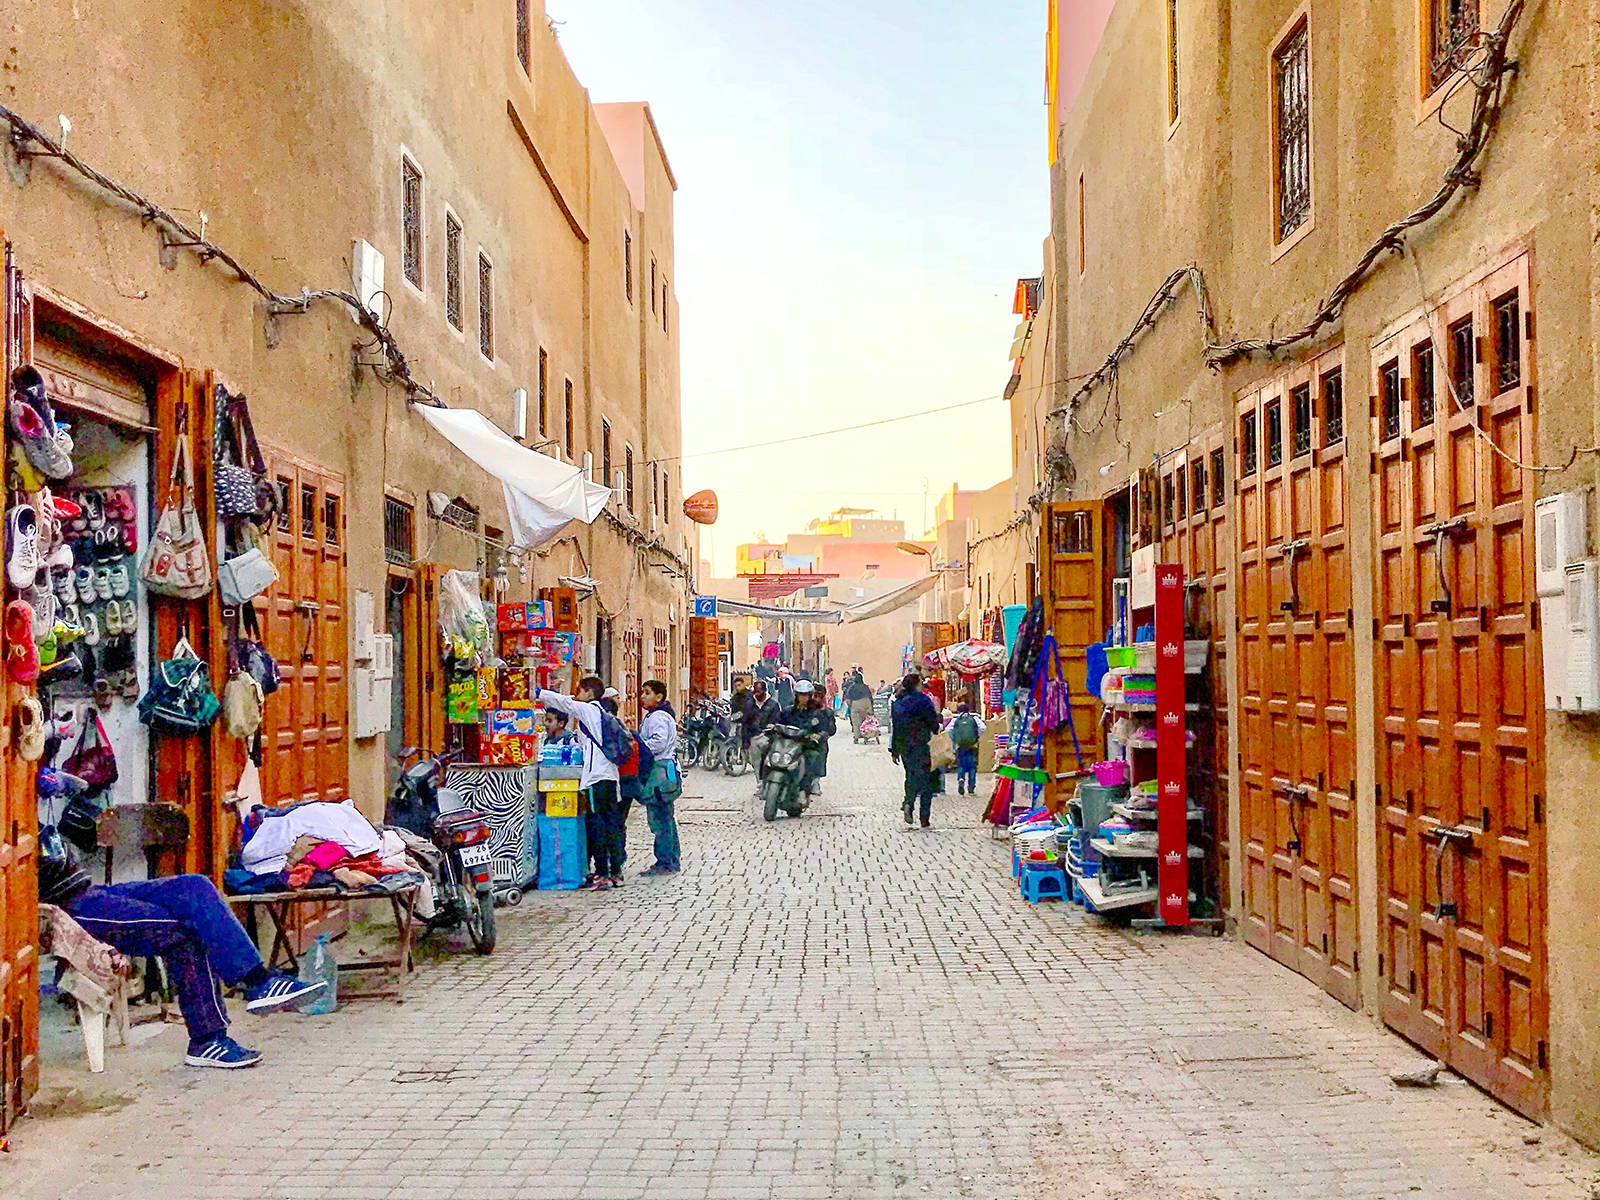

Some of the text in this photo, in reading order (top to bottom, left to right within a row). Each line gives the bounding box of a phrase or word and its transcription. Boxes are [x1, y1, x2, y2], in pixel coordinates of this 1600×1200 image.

[449, 680, 475, 695] TACOS
[509, 736, 523, 762] TACOS
[464, 854, 490, 865] 49744
